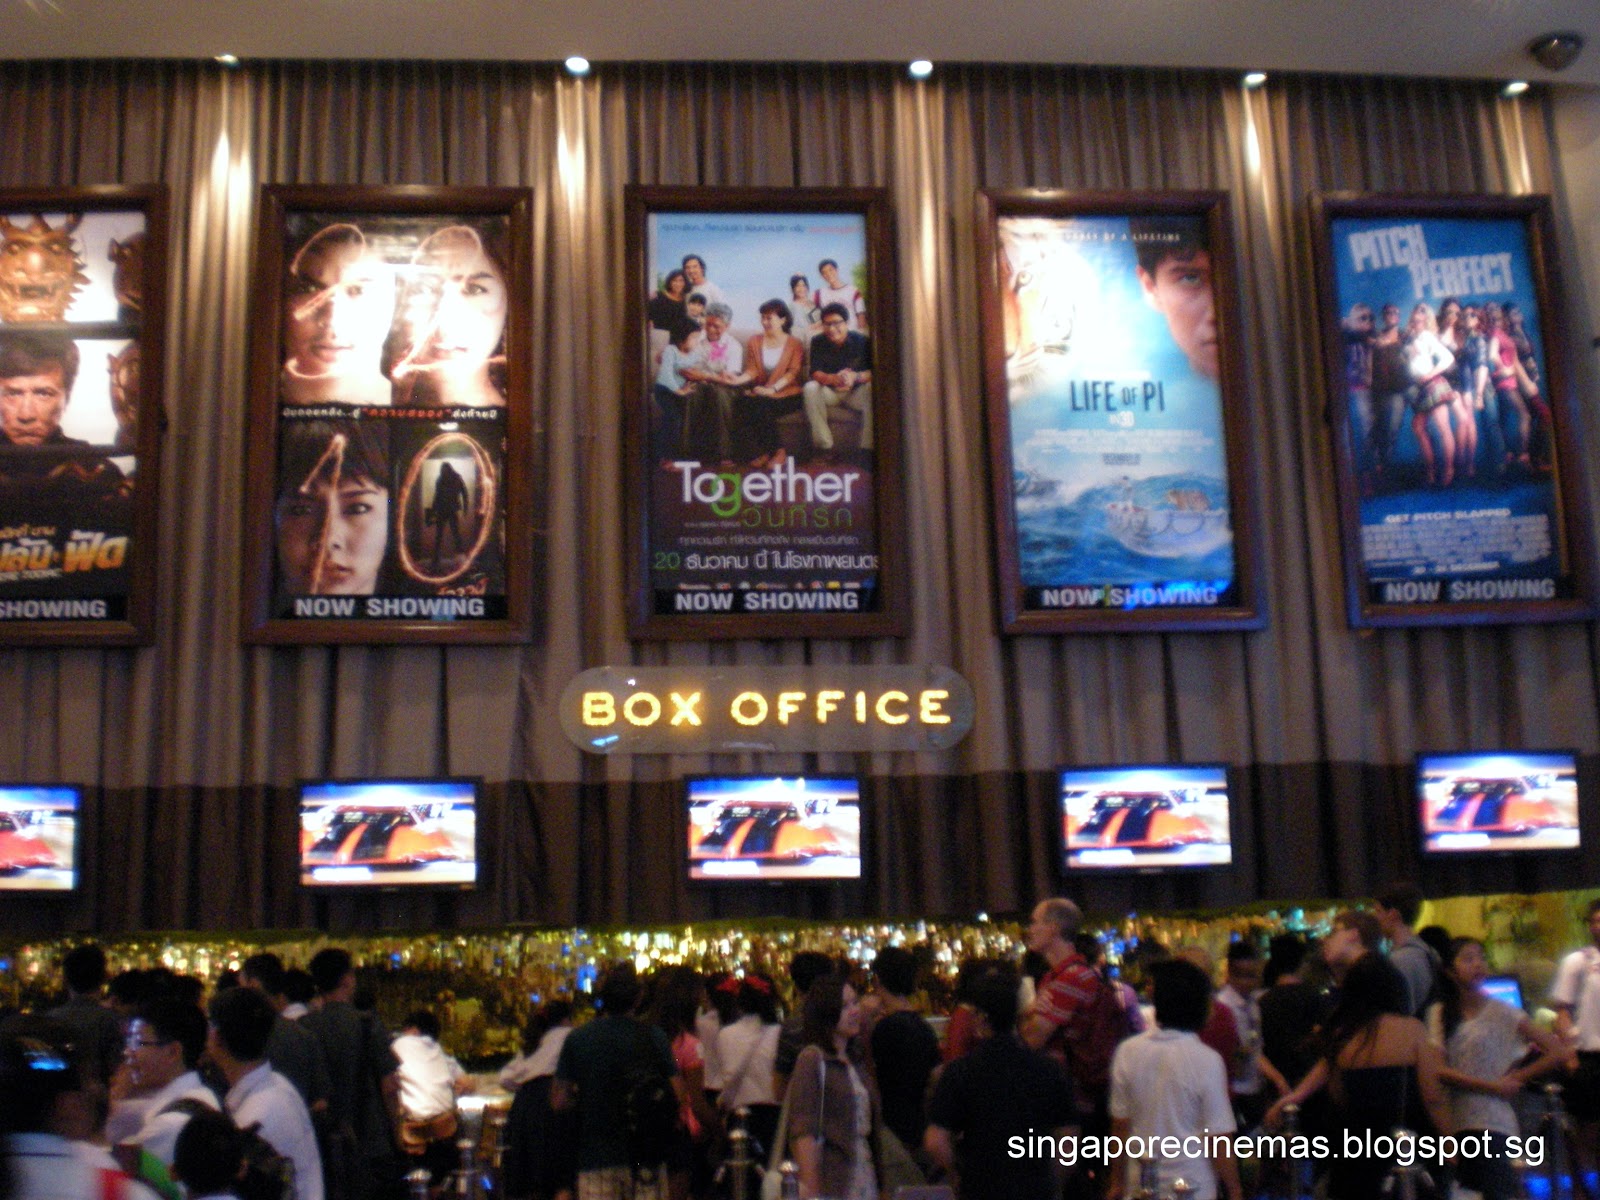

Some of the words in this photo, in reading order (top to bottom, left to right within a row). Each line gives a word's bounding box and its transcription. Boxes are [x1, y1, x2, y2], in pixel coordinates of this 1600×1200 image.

[1348, 223, 1429, 273] PITCH
[1409, 251, 1514, 299] PERFECT
[1070, 380, 1117, 412] LIFE
[1121, 386, 1138, 406] OF
[1143, 380, 1165, 412] PI
[673, 456, 860, 517] Together
[675, 592, 734, 611] NOW
[744, 591, 859, 611] SHOWING
[1041, 588, 1099, 607] NOW
[1109, 586, 1219, 606] SHOWING
[1385, 581, 1441, 603] NOW
[1450, 578, 1556, 601] SHOWING
[294, 597, 355, 617] NOW
[366, 597, 485, 617] SHOWING
[581, 690, 702, 727] BOX
[730, 688, 952, 726] OFFICE
